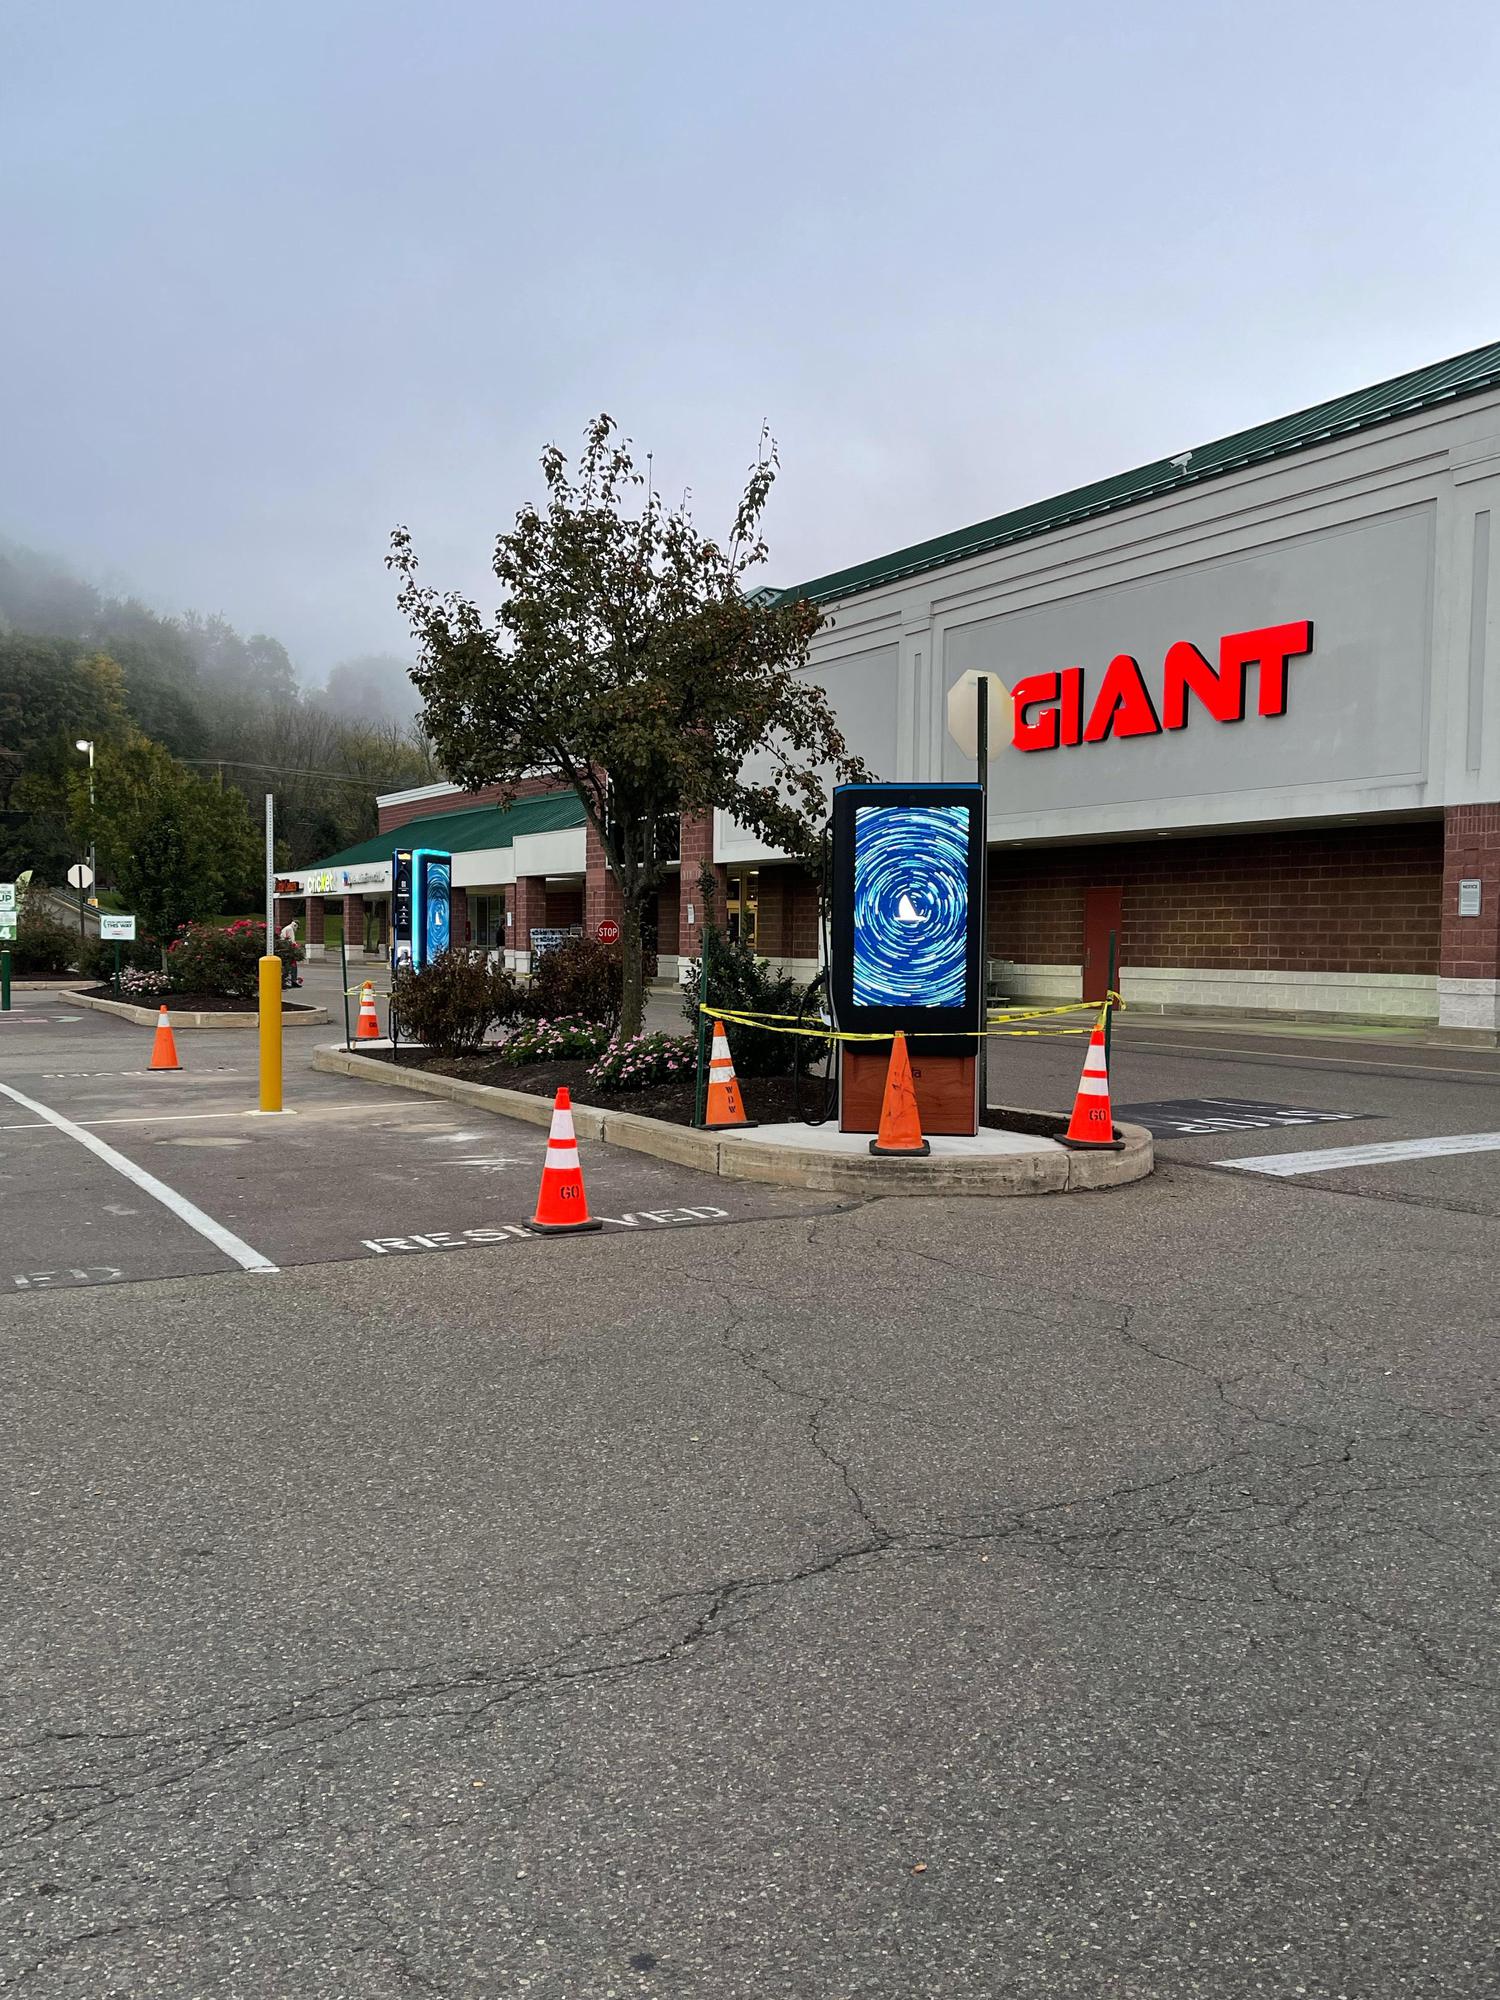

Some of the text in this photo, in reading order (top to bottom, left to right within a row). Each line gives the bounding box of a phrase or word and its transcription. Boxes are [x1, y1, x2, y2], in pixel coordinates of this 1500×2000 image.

[1011, 619, 1313, 752] GIANT
[599, 927, 618, 937] STOP
[360, 1206, 730, 1253] RESVED
